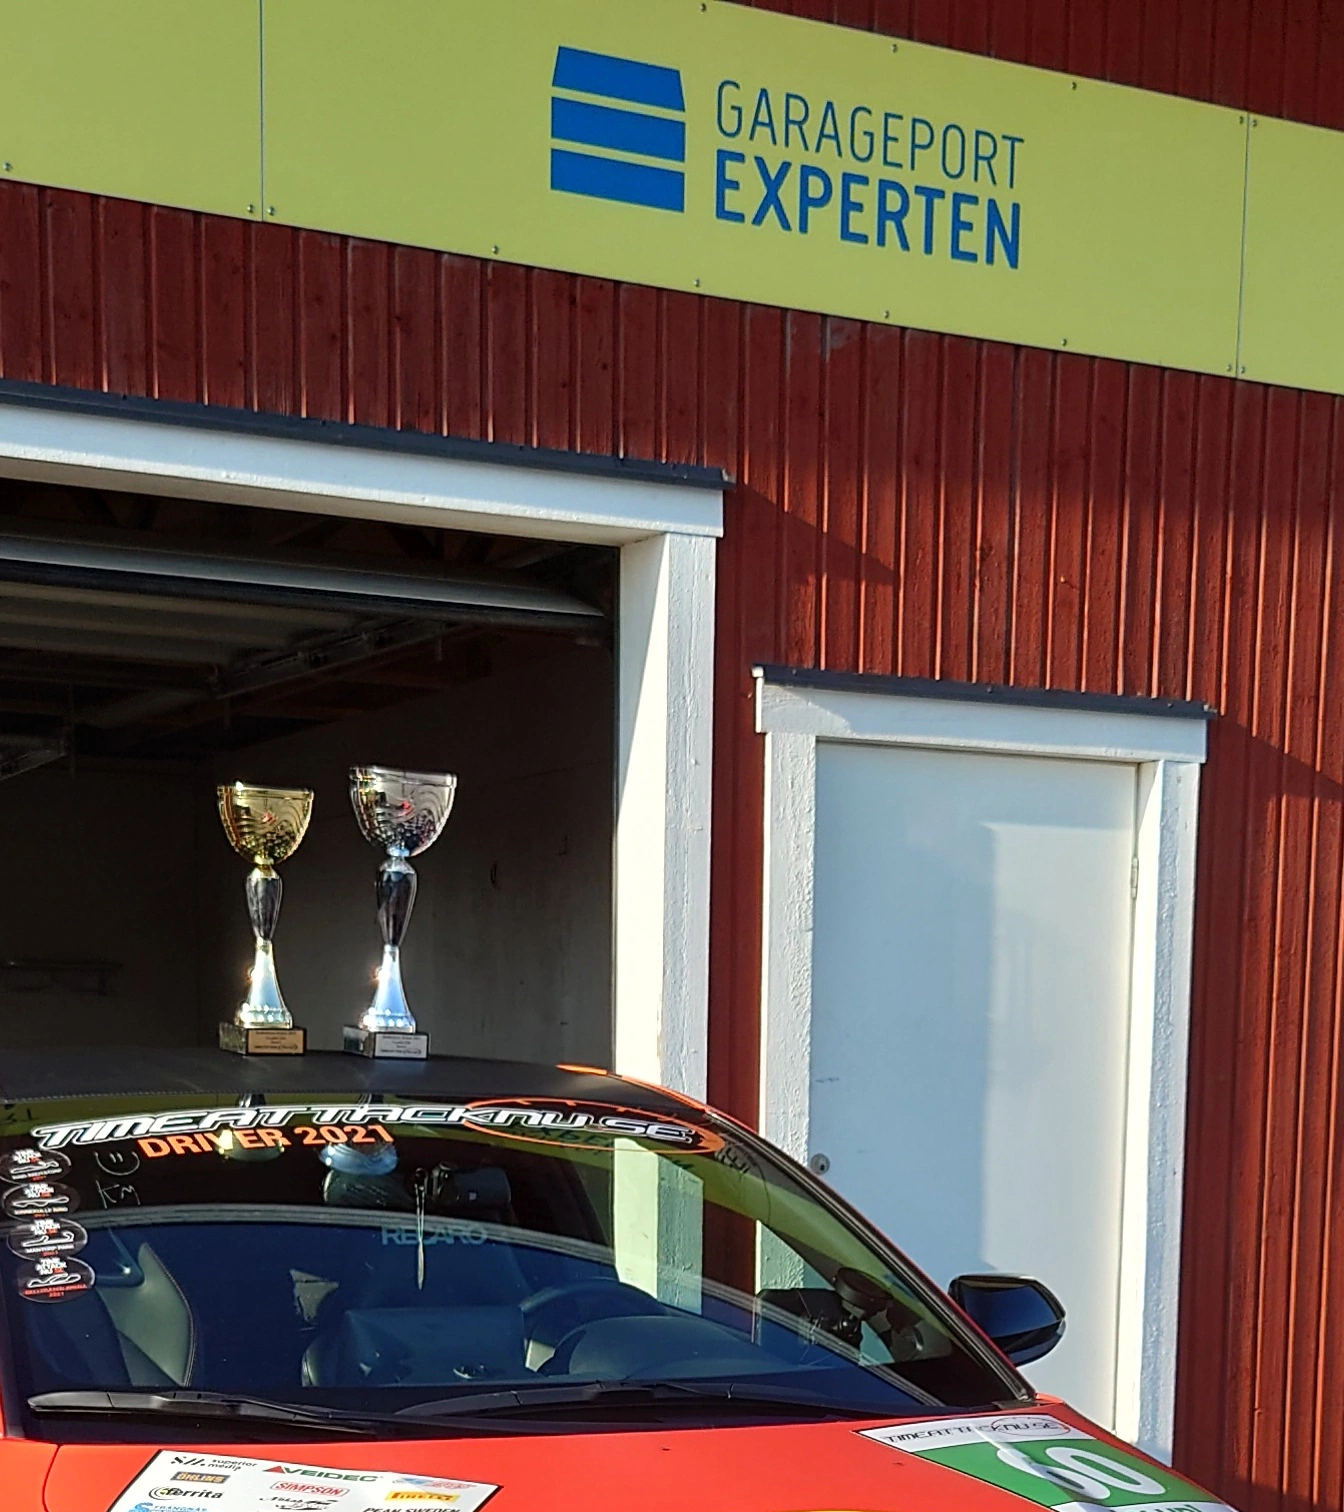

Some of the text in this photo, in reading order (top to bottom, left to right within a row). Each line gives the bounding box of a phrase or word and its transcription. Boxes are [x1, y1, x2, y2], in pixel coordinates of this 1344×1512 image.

[716, 79, 1025, 189] GARAGEPORT
[715, 148, 1021, 269] EXPERTEN
[135, 1123, 396, 1159] DRIVER 2021
[381, 1224, 487, 1246] RECARO
[208, 1463, 242, 1472] media
[211, 1459, 258, 1468] superior
[997, 1445, 1167, 1500] 60
[275, 1482, 345, 1497] SIMPSON
